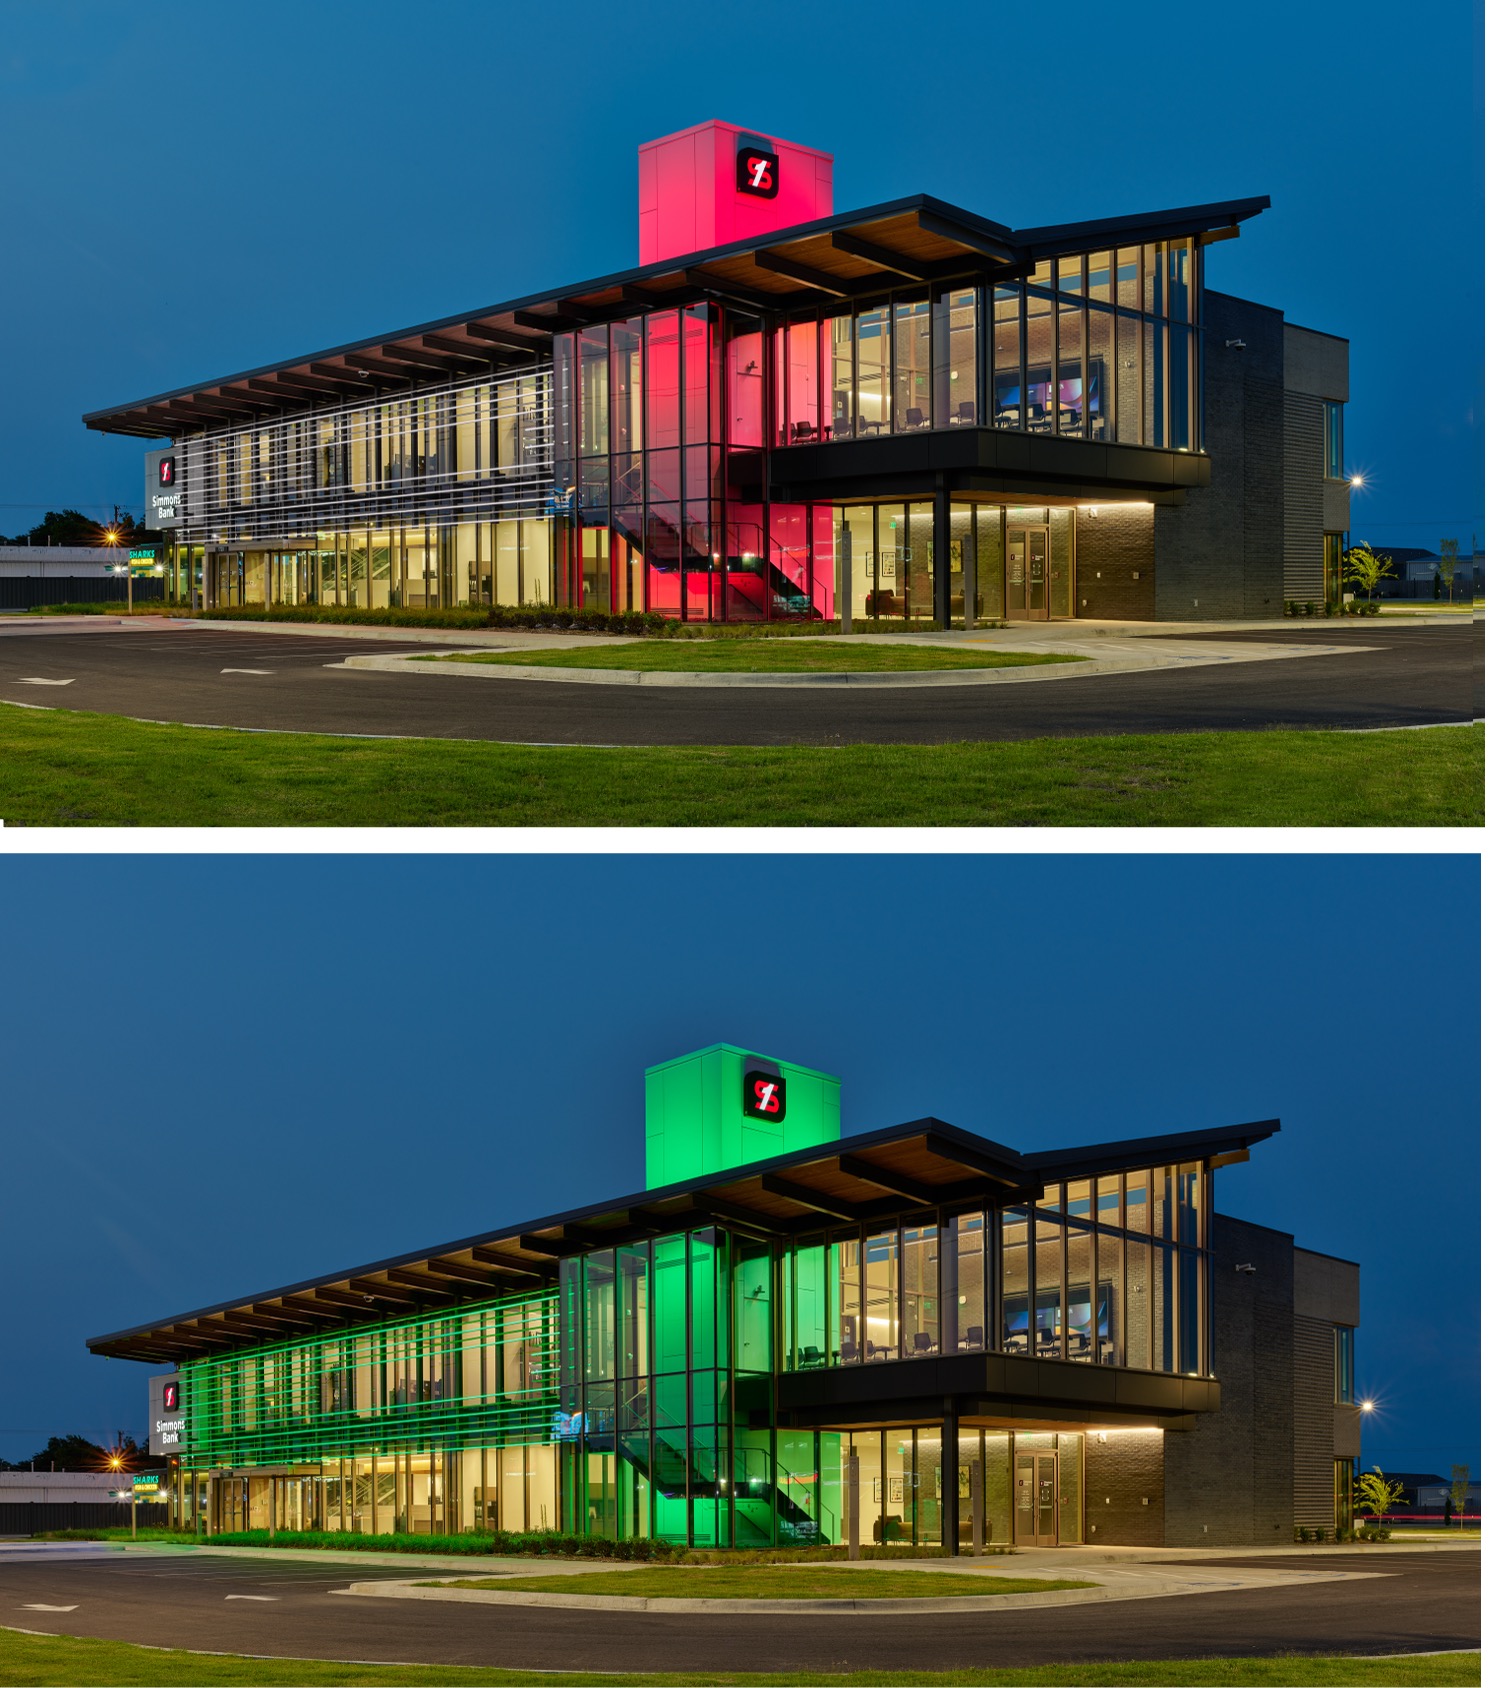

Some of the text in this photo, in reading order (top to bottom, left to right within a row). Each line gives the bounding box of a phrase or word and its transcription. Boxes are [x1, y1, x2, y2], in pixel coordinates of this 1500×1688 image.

[152, 495, 181, 508] Simmons
[158, 507, 175, 519] Bank
[129, 549, 155, 559] SHARKS
[156, 1420, 185, 1433] Simmons
[162, 1432, 179, 1444] Bank
[133, 1475, 159, 1485] SHARKS
